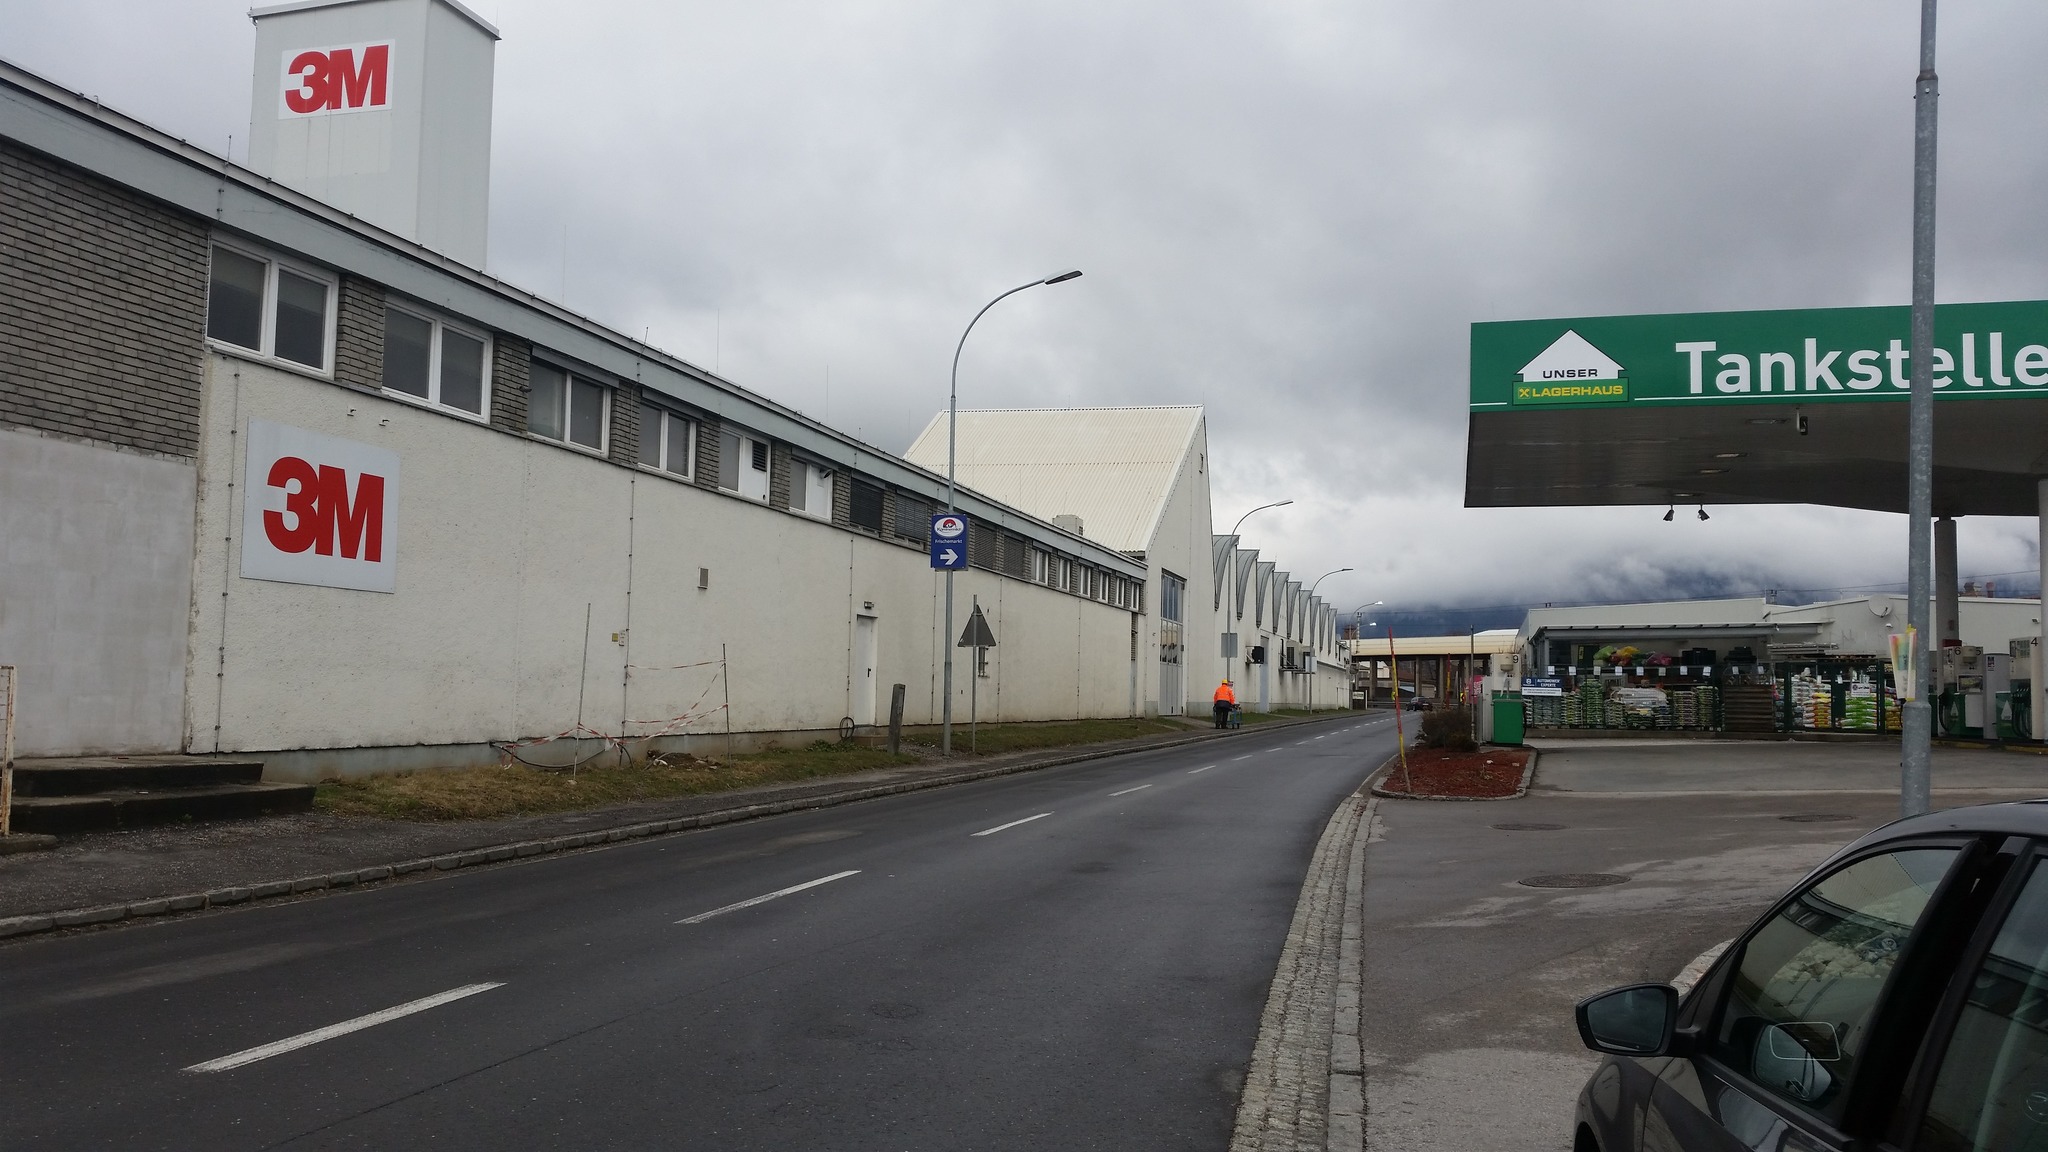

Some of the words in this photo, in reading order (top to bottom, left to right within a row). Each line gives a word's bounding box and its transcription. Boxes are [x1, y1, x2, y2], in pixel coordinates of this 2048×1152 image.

[284, 44, 390, 114] 3M
[1675, 332, 2048, 394] Tankstelle
[1543, 369, 1598, 379] UNSER
[1532, 386, 1623, 397] LAGERHAUS
[262, 456, 385, 563] 3M
[2030, 637, 2038, 646] 4
[1954, 647, 1961, 655] 6
[1513, 655, 1518, 663] 9
